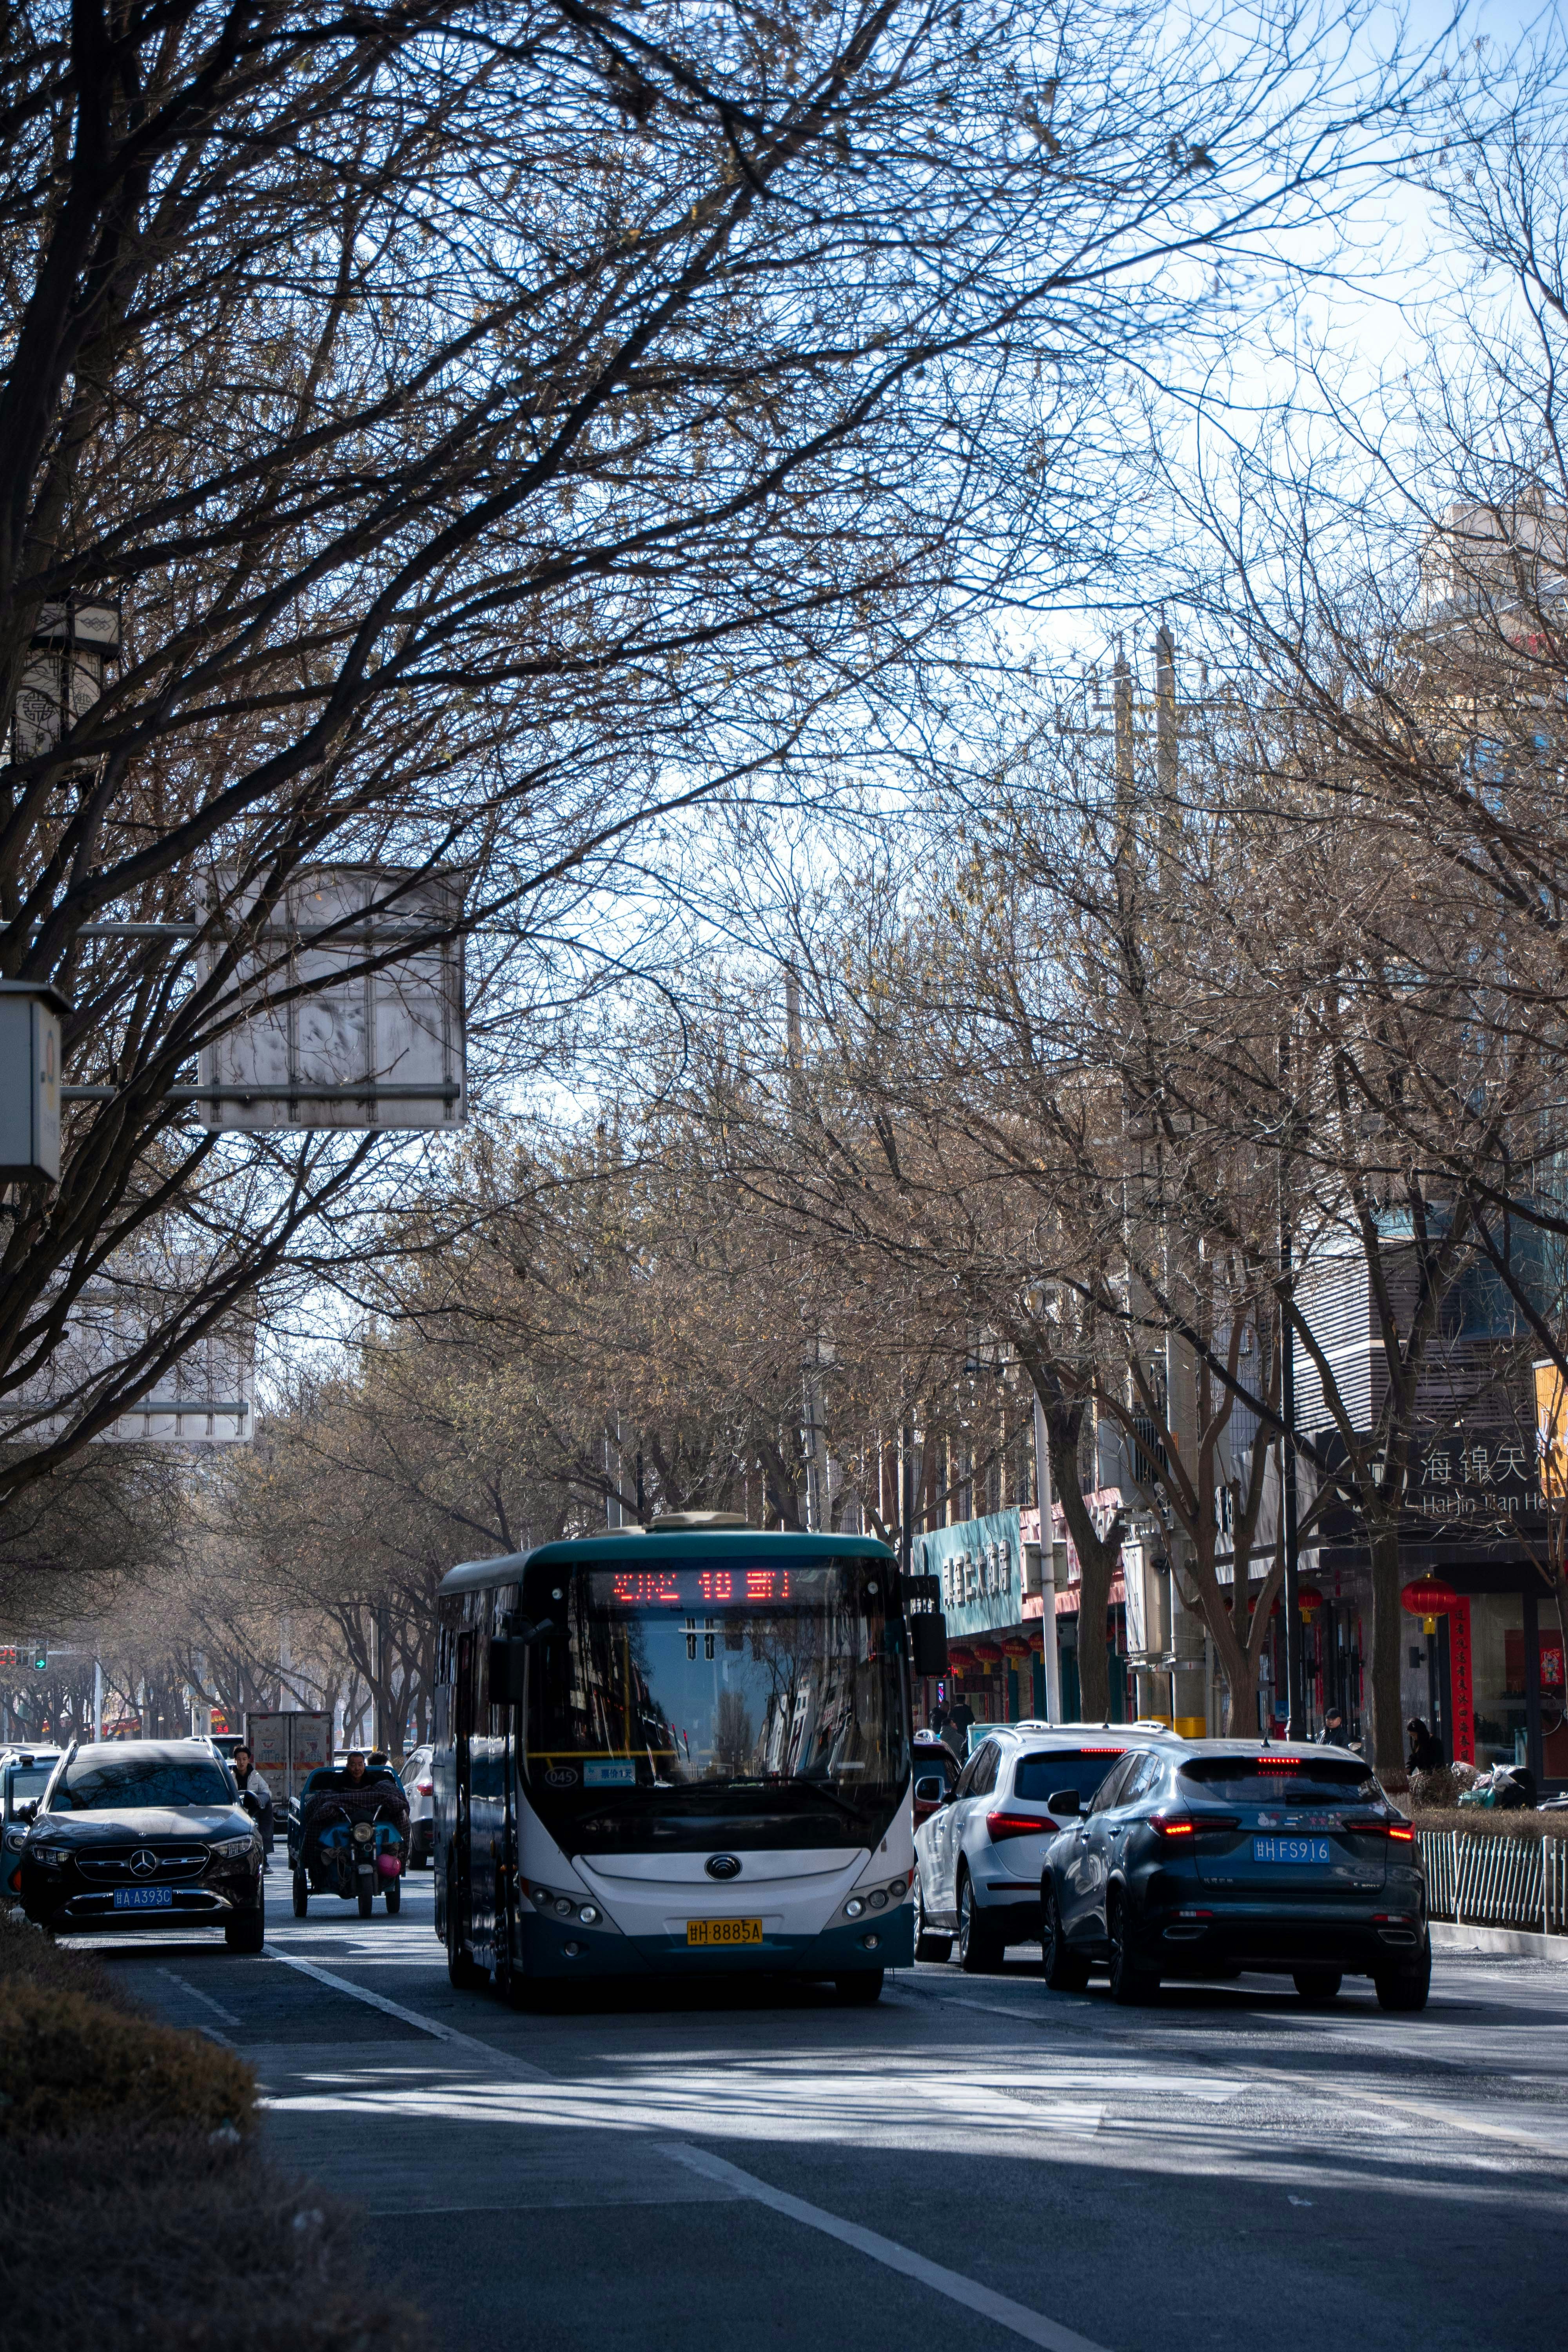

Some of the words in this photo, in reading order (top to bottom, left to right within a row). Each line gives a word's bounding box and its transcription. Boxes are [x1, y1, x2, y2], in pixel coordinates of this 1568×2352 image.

[1421, 1445, 1539, 1486] 海锦天
[550, 1771, 573, 1783] 045
[601, 1768, 633, 1779] 票价1元
